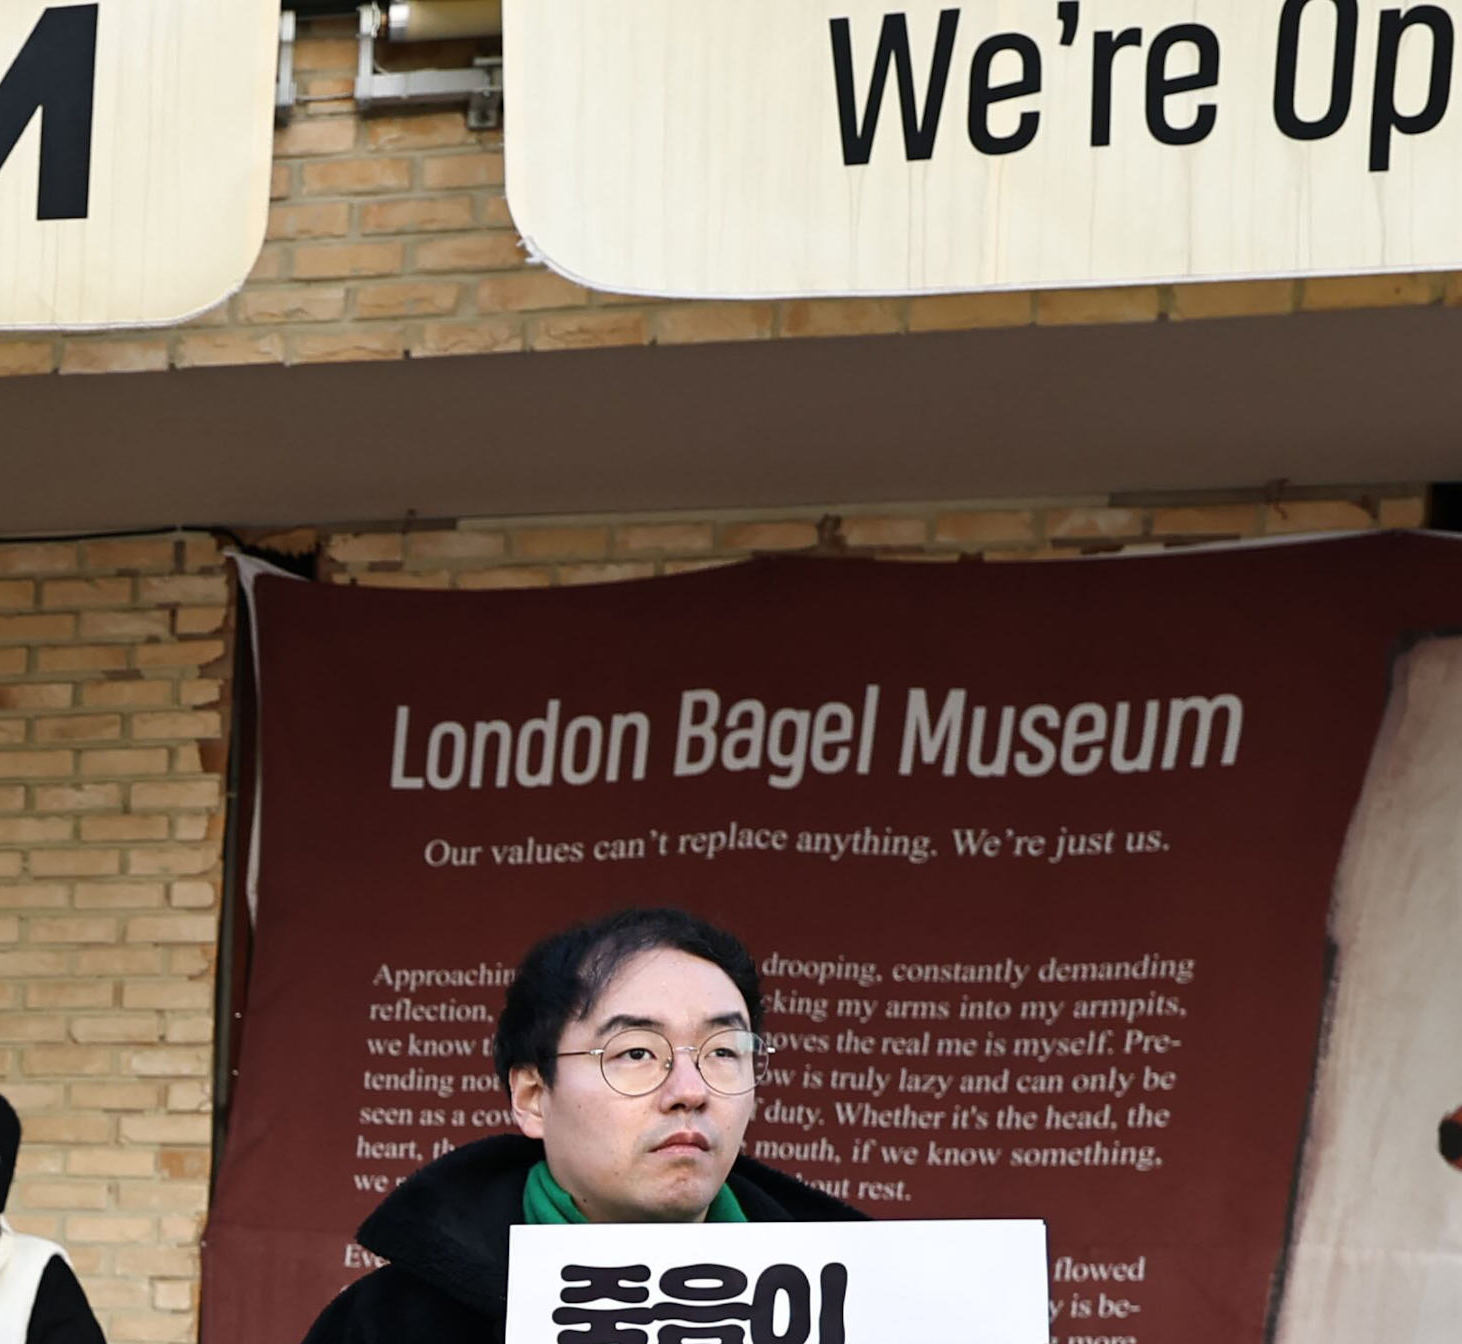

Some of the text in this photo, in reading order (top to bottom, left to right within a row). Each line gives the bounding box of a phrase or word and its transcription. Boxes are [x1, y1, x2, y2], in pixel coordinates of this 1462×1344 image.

[830, 0, 1221, 167] We’re
[390, 685, 1244, 791] London Bagel Museum
[423, 838, 481, 867] Our
[491, 836, 584, 866] values
[678, 822, 787, 858] replace
[796, 825, 938, 864] anything.
[1050, 824, 1114, 864] just
[1125, 829, 1171, 853] us.
[373, 952, 1195, 992] Approachin drooping, constantly demanding
[369, 988, 1187, 1025] reflection, cking my arms into my armpits,
[367, 1036, 402, 1056] we
[408, 1033, 475, 1057] know
[837, 1028, 875, 1054] the
[881, 1031, 930, 1056] real
[937, 1038, 976, 1056] me
[985, 1031, 1006, 1056] is
[1013, 1029, 1114, 1062] myself.
[1123, 1029, 1181, 1054] Pre-
[364, 1067, 454, 1098] tending
[462, 1072, 500, 1092] not
[802, 1066, 823, 1089] is
[830, 1068, 890, 1096] truly
[899, 1068, 952, 1098] lazy
[959, 1068, 1009, 1093] and
[1016, 1074, 1063, 1093] can
[1072, 1066, 1133, 1097] only
[1143, 1065, 1177, 1090] be
[359, 1106, 413, 1125] seen
[419, 1108, 445, 1126] as
[451, 1109, 465, 1127] a
[764, 1098, 825, 1130] duty.
[835, 1102, 946, 1130] Whether
[952, 1105, 989, 1130] it's
[996, 1105, 1037, 1130] the
[1045, 1104, 1117, 1130] head,
[1127, 1103, 1170, 1129] the
[356, 1135, 423, 1160] heart,
[754, 1138, 842, 1163] mouth,
[851, 1138, 876, 1163] if
[880, 1145, 918, 1165] we
[927, 1141, 1002, 1166] know
[1010, 1140, 1163, 1171] something,
[354, 1174, 389, 1192] we
[858, 1178, 912, 1201] rest.
[1054, 1256, 1146, 1282] flowed
[1071, 1293, 1092, 1318] is
[1098, 1293, 1141, 1319] be-
